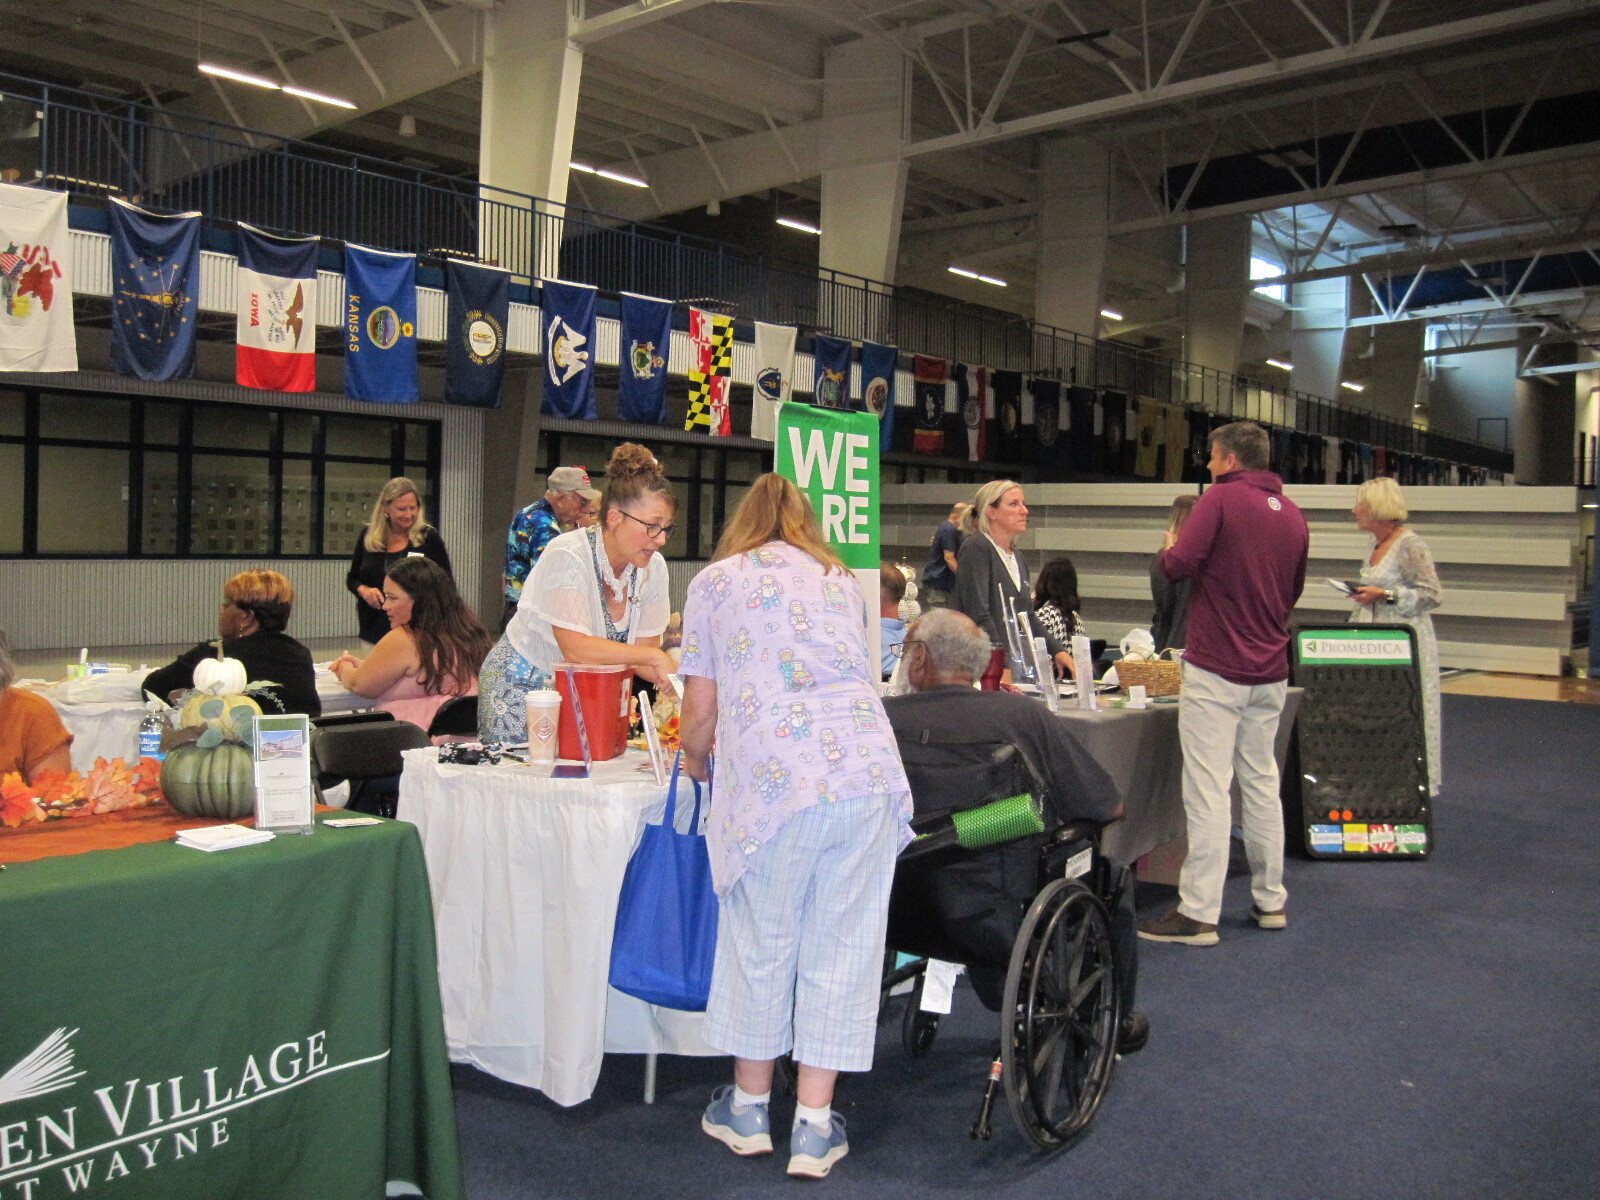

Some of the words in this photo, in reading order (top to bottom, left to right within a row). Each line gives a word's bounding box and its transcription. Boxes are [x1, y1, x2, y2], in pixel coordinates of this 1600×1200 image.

[250, 292, 260, 328] IOWA
[349, 294, 360, 353] KANSAS
[788, 426, 870, 493] WE
[804, 493, 870, 544] RE
[1321, 641, 1403, 655] PROMEDICA
[93, 1029, 330, 1137] VILLAGE
[62, 1117, 230, 1193] WAYNE
